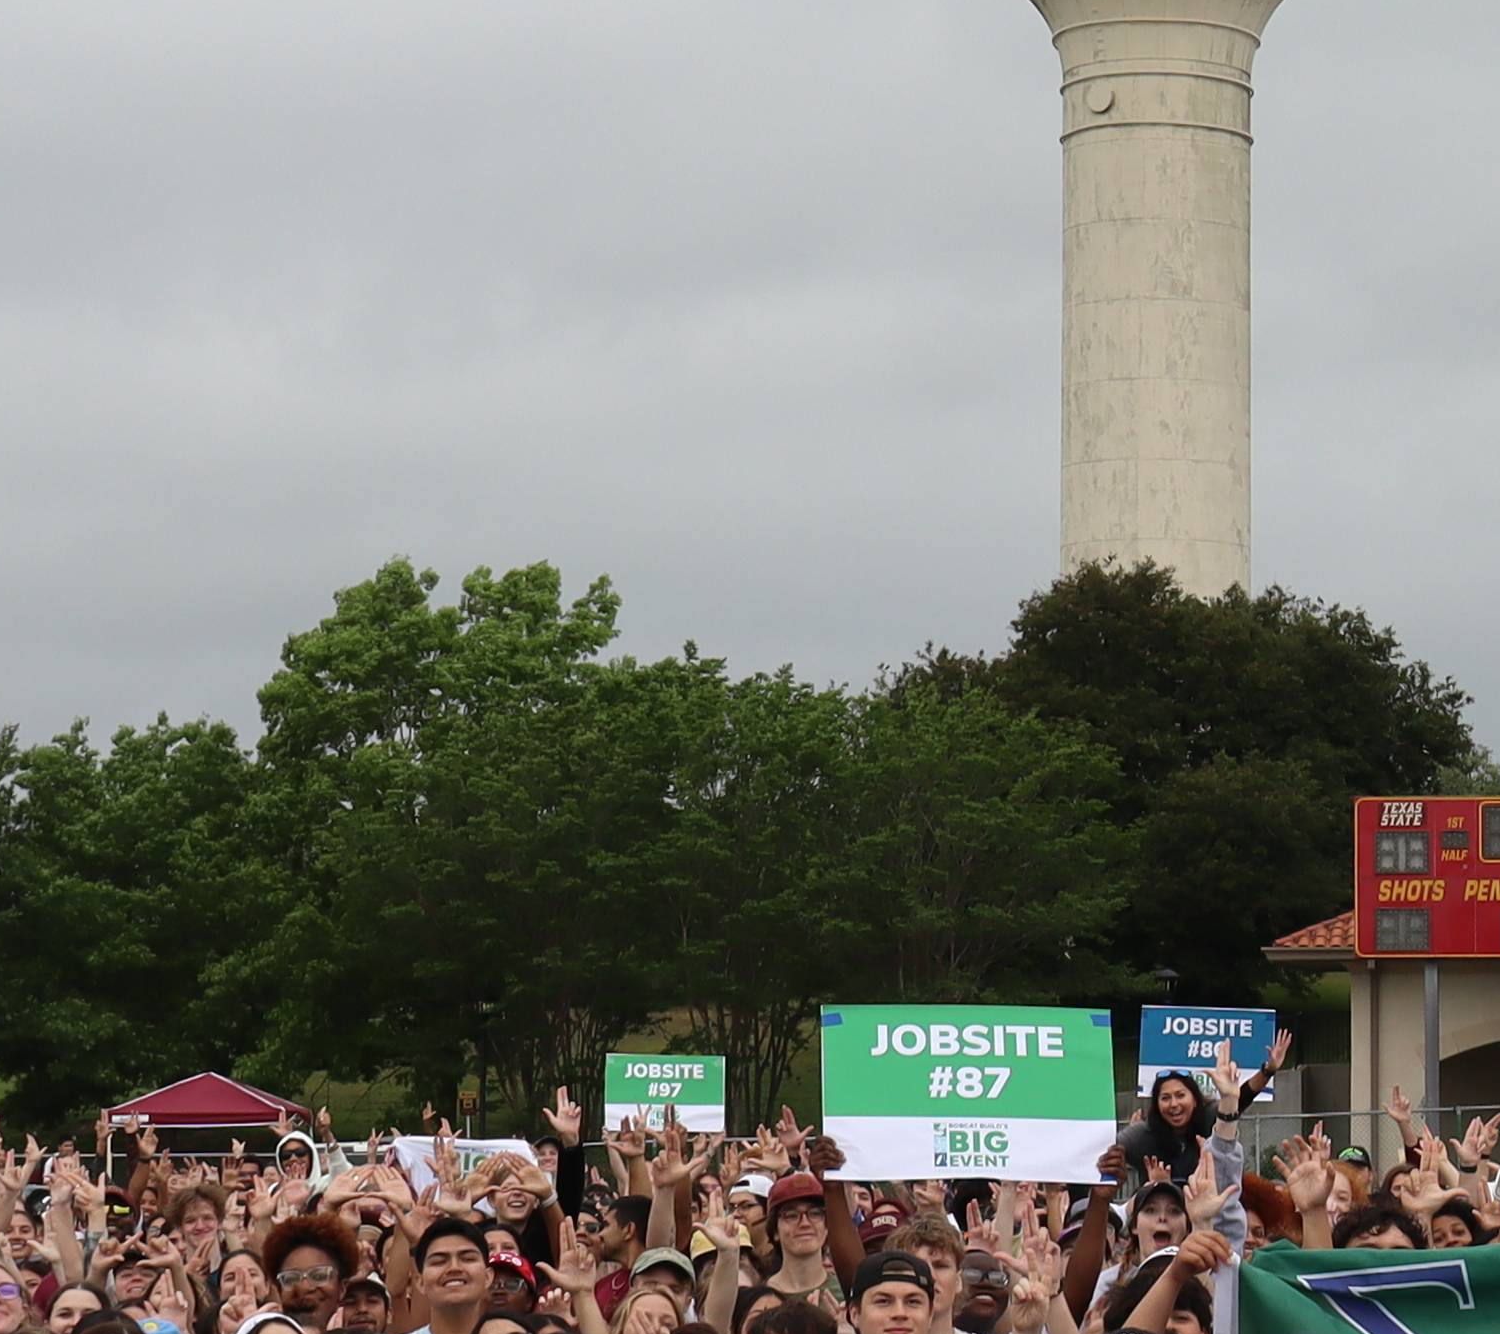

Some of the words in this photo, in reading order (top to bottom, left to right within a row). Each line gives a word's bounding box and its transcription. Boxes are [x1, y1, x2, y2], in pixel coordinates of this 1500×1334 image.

[1382, 802, 1423, 814] TEXAS
[1380, 814, 1423, 827] STATE
[1446, 816, 1465, 829] 1ST
[1441, 849, 1468, 861] HALF
[1378, 879, 1446, 902] SHOTS
[1162, 1016, 1253, 1038] JOBSITE
[871, 1024, 1064, 1058] JOBSITE
[624, 1063, 705, 1079] JOBSITE
[648, 1082, 682, 1098] #97
[928, 1066, 1012, 1099] #87
[948, 1122, 978, 1130] BOBCAT
[979, 1122, 1009, 1130] BUILD'S
[949, 1130, 1009, 1153] BIG
[949, 1154, 1010, 1168] EVENT
